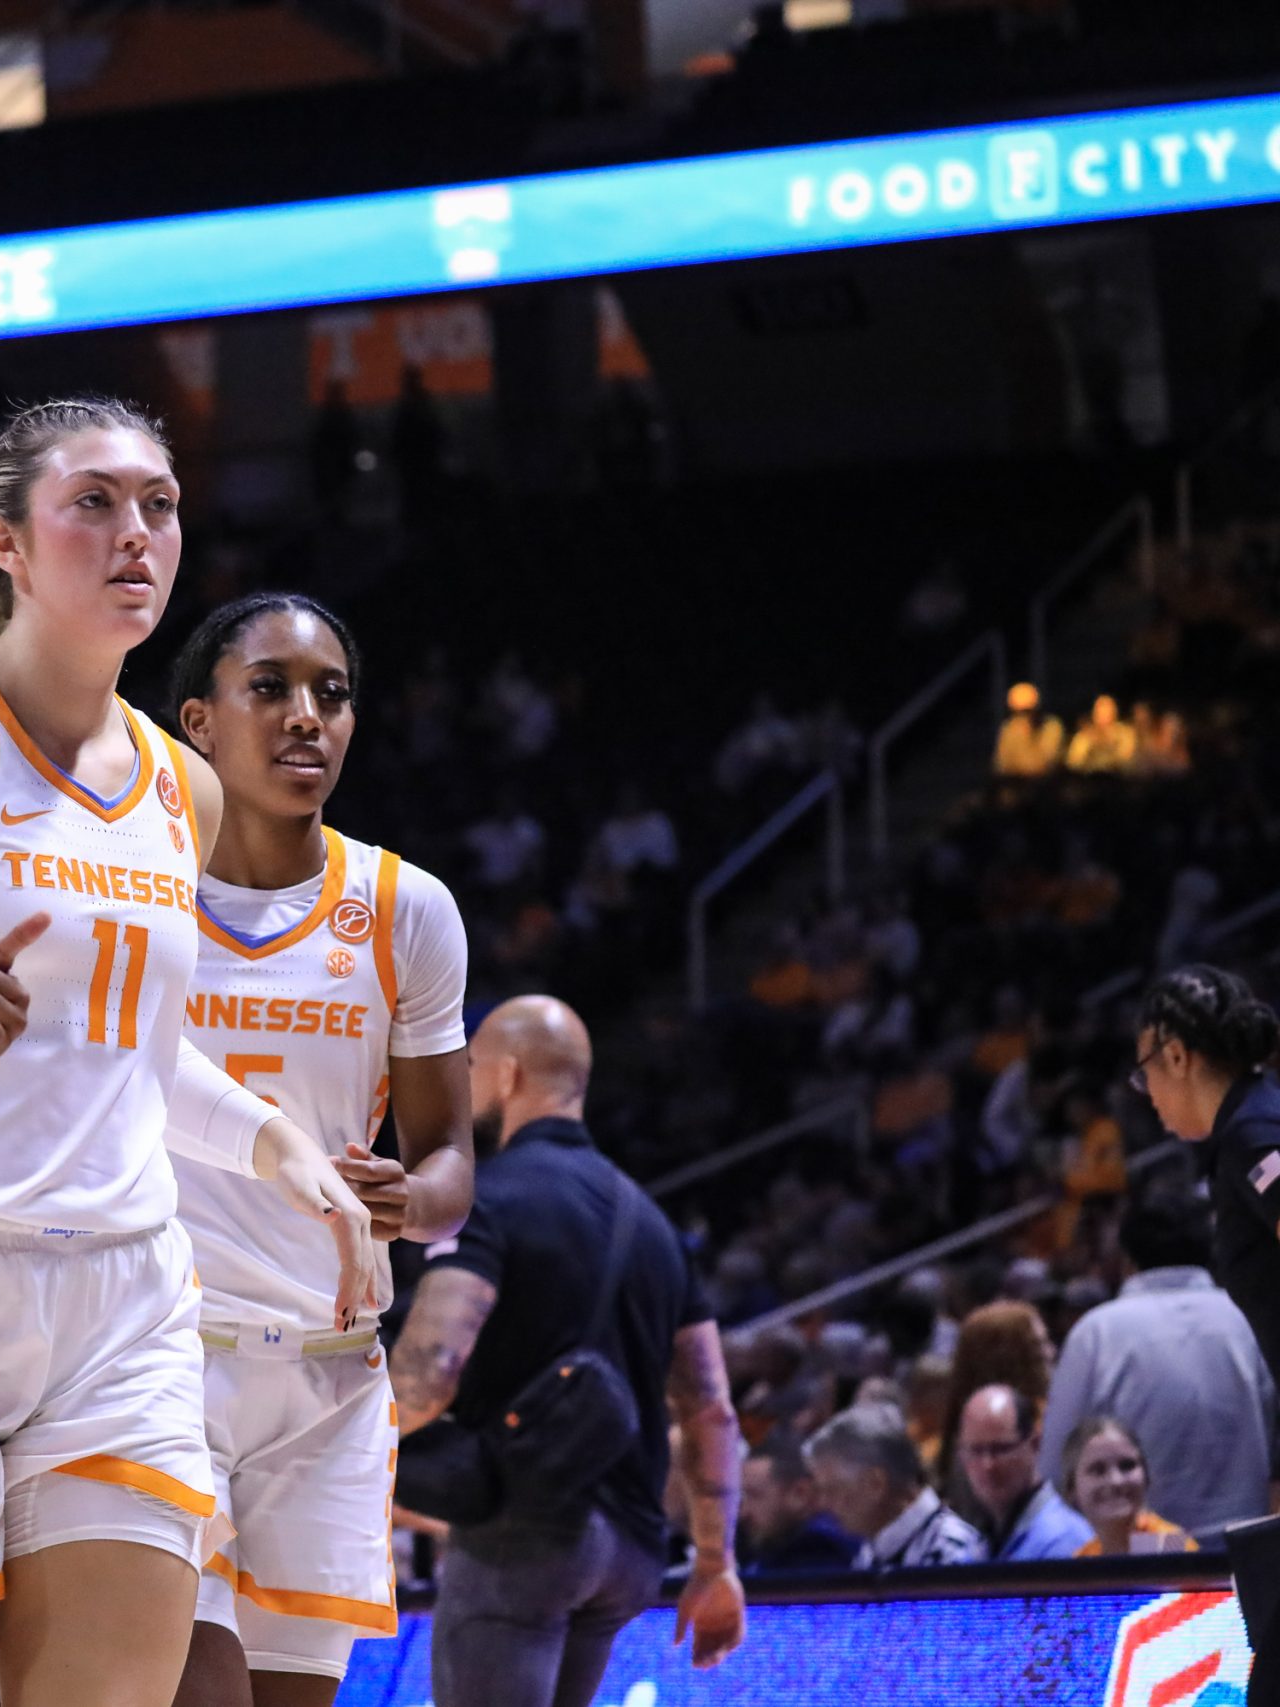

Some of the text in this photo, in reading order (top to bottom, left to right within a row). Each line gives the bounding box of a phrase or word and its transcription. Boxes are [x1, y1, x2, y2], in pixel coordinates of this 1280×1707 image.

[788, 156, 978, 228] FOOD
[1068, 128, 1237, 198] CITY
[87, 918, 150, 1050] 11
[184, 993, 369, 1039] NNESSEE
